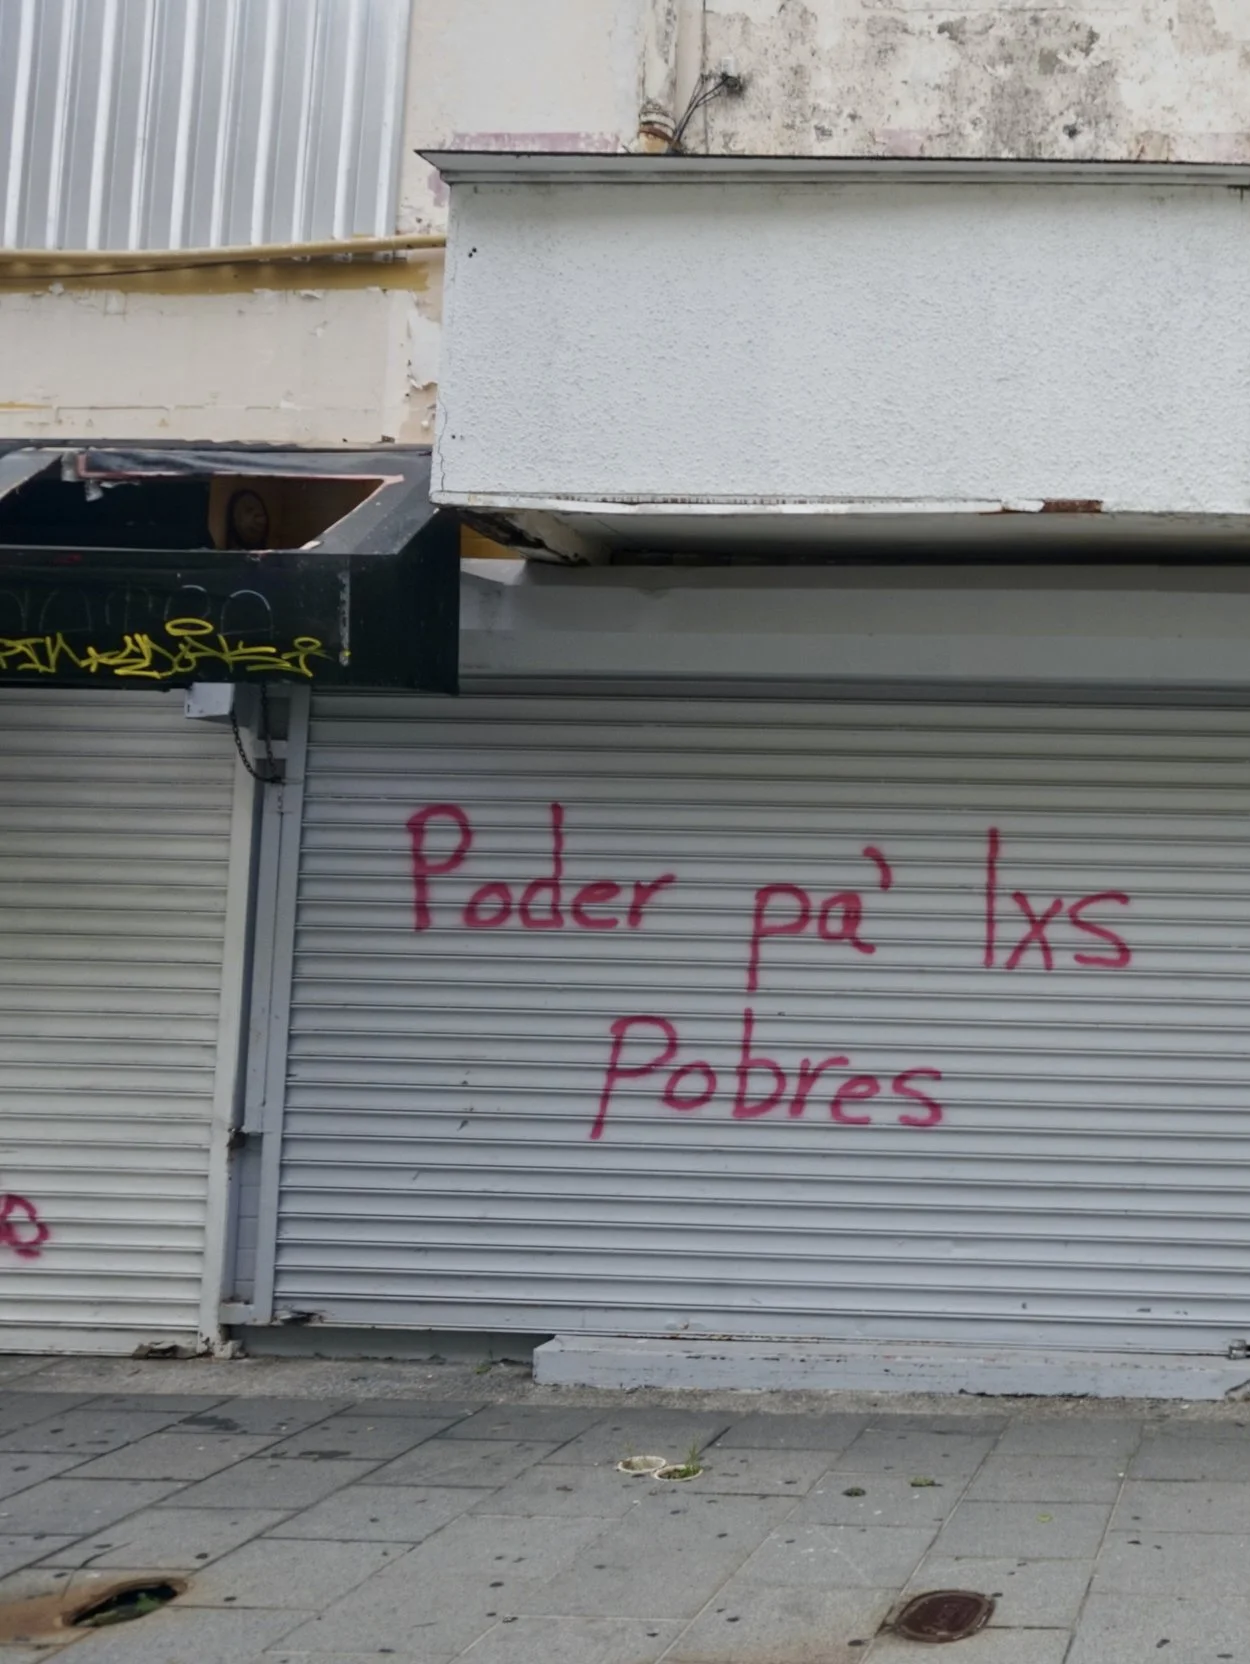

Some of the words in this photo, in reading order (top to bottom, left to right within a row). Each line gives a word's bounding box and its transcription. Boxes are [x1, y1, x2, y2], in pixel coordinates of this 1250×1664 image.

[405, 801, 677, 933] Poder
[983, 826, 1132, 971] lxs
[589, 1007, 944, 1140] Pobres
